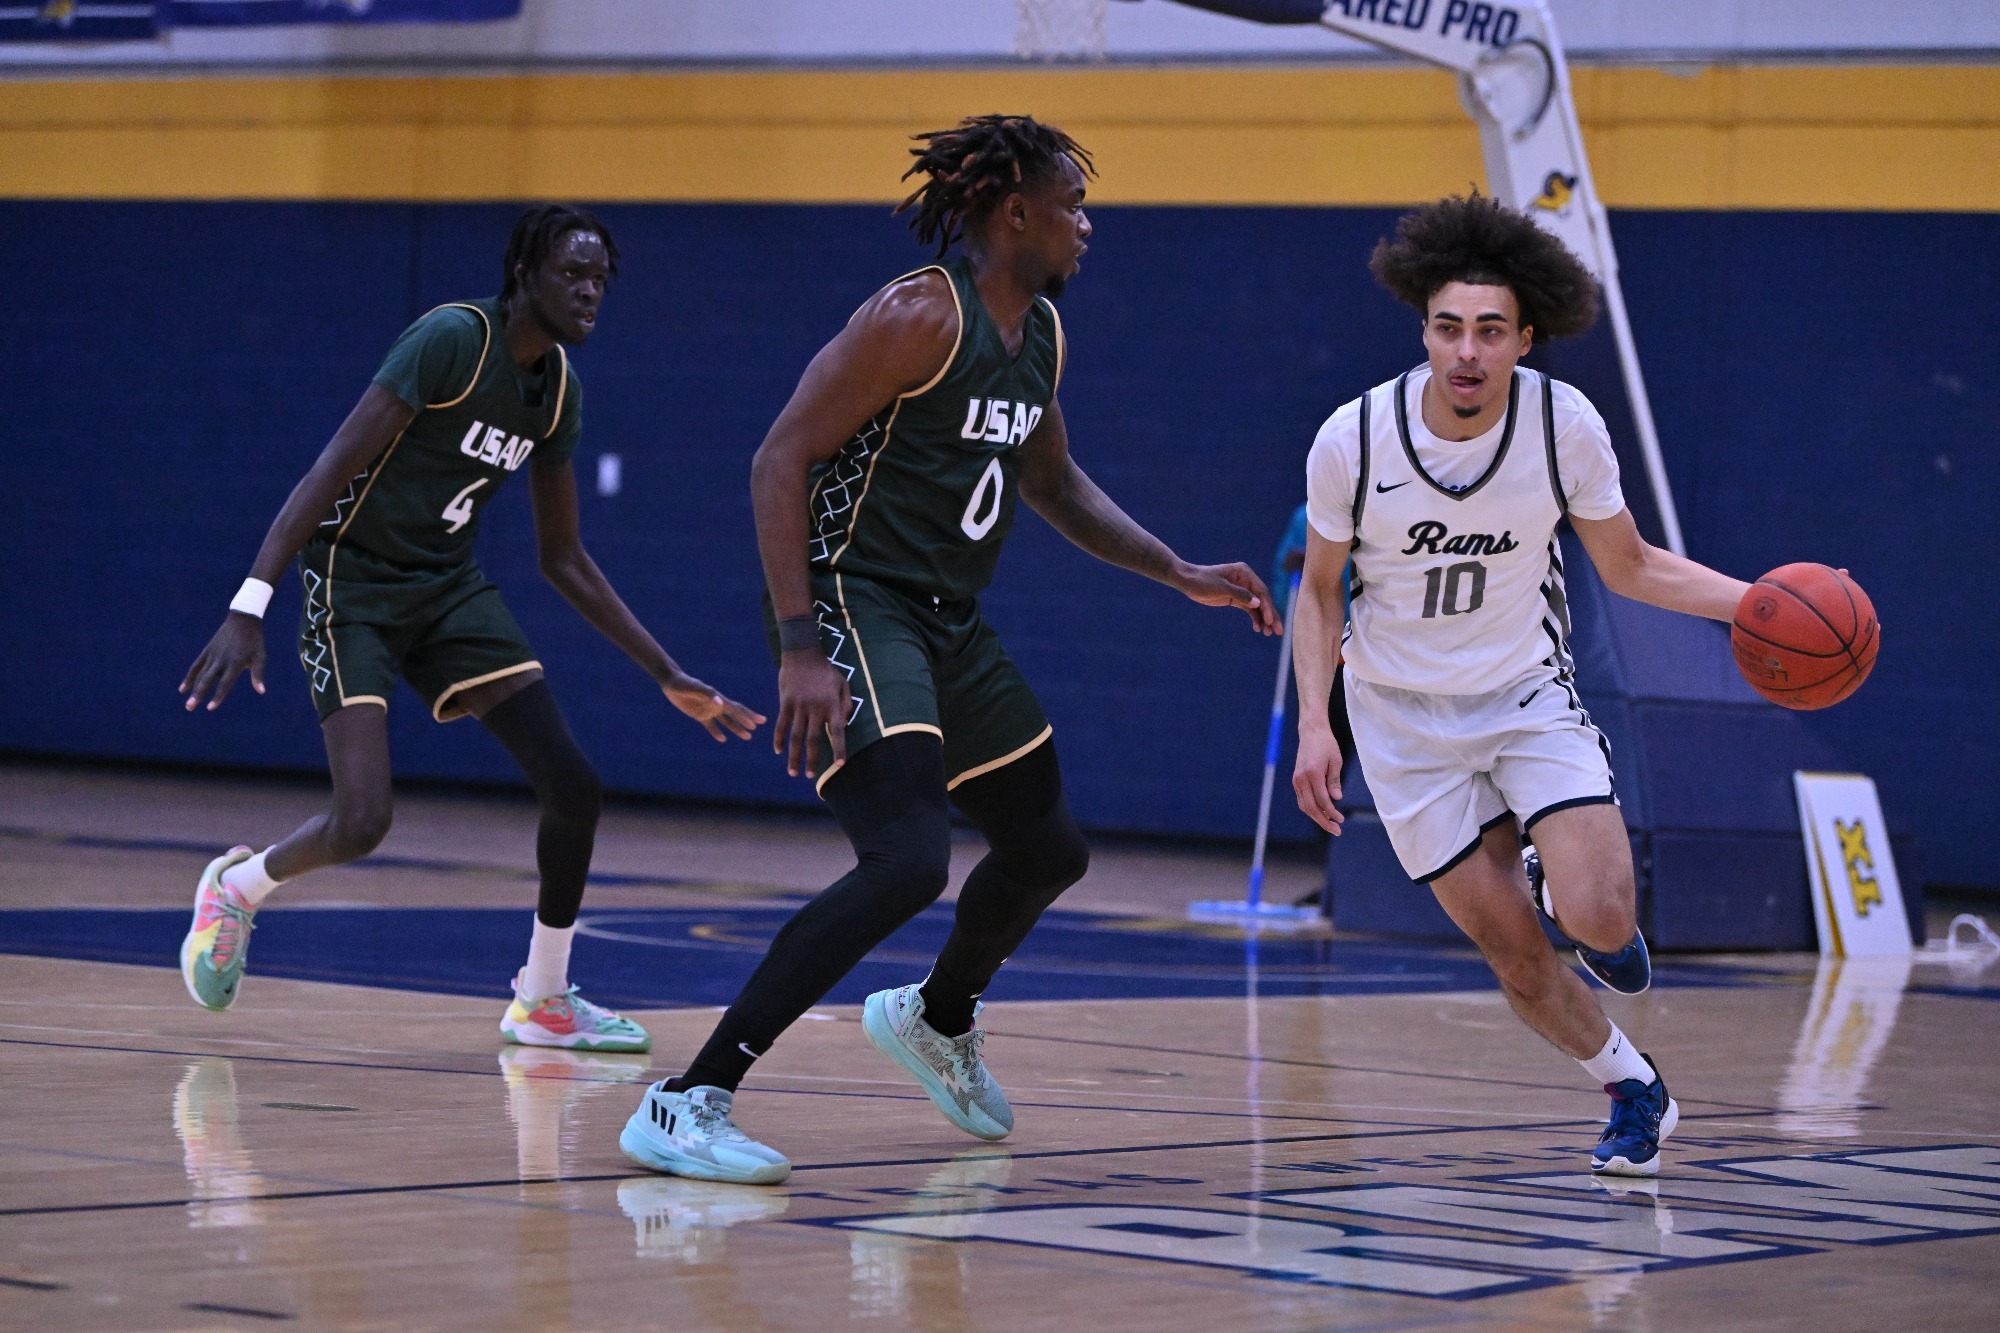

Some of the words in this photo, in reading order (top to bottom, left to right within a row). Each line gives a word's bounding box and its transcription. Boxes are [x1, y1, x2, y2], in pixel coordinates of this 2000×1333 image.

[1440, 0, 1518, 48] PRO
[460, 420, 535, 471] USAO
[960, 396, 1044, 446] USAO
[441, 477, 489, 534] 4
[961, 456, 1004, 541] 0
[1401, 520, 1519, 556] Rams
[1421, 560, 1487, 619] 10
[768, 1172, 1206, 1204] TEXAS
[1250, 1135, 1810, 1174] WESLEAN
